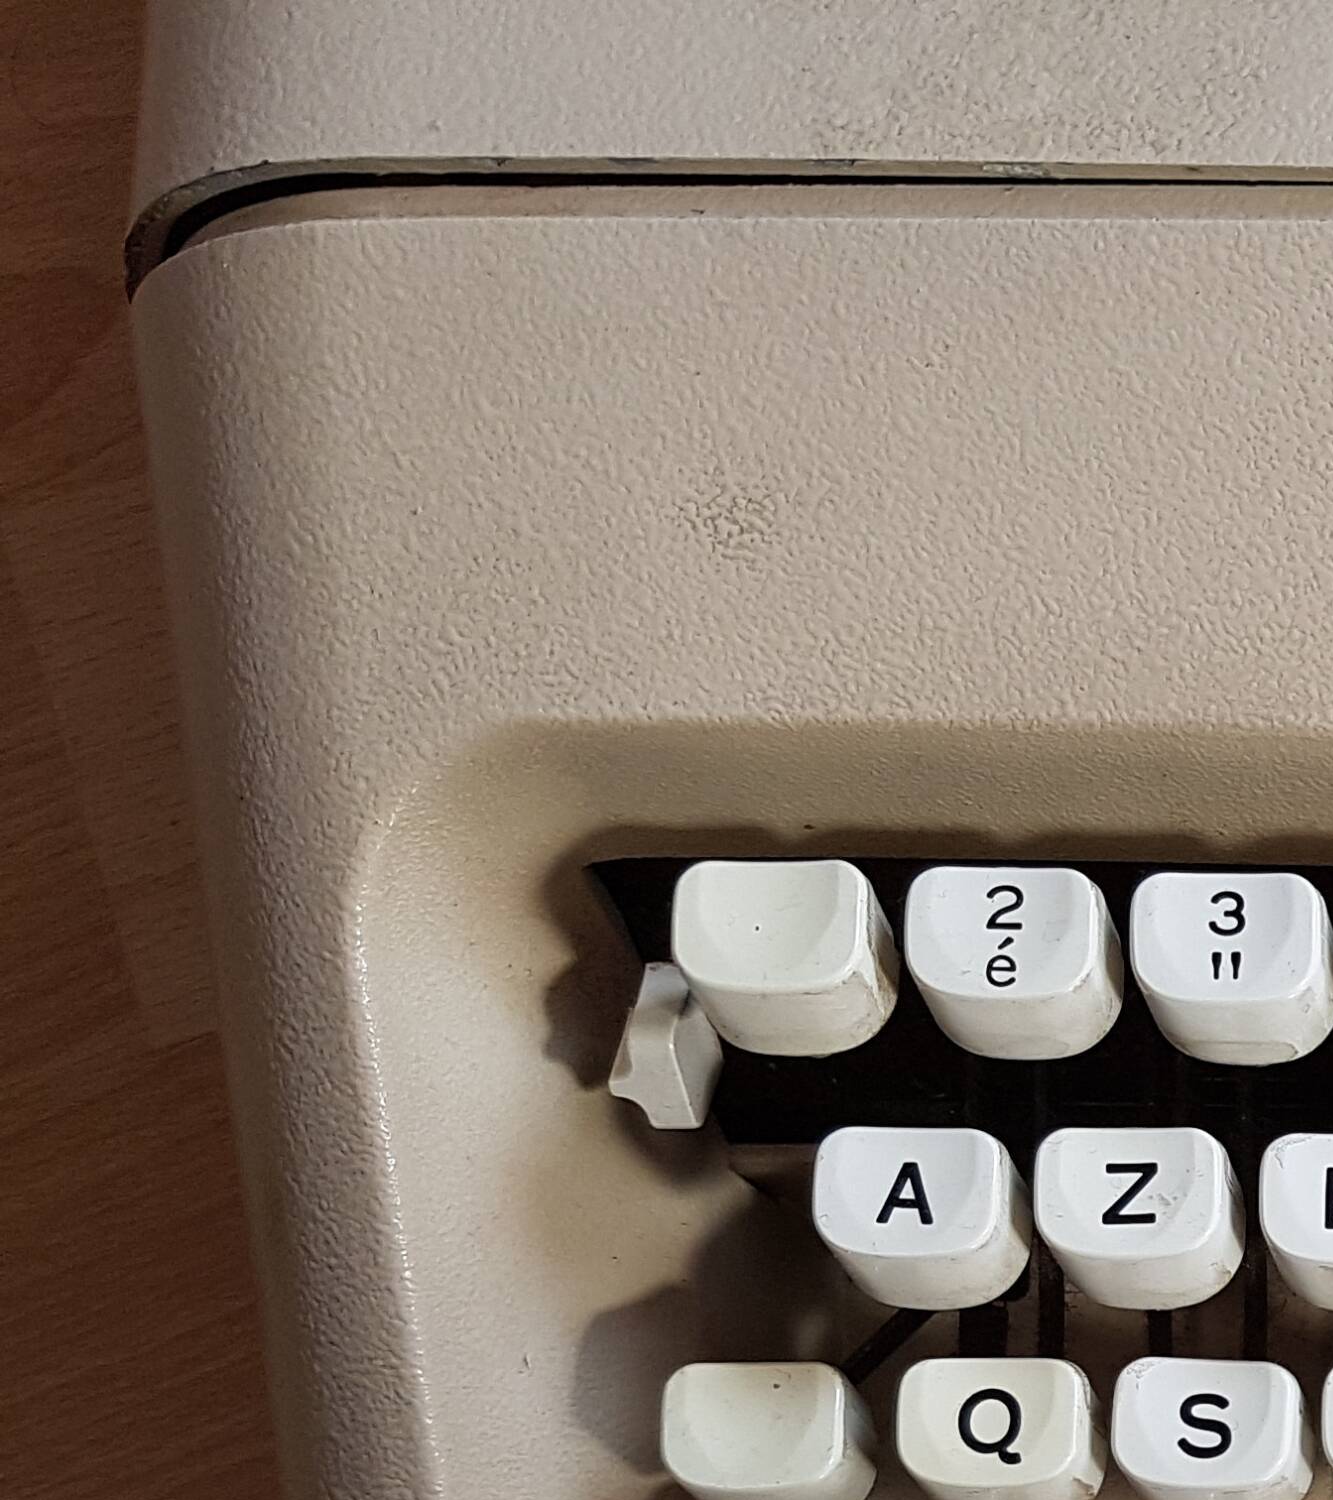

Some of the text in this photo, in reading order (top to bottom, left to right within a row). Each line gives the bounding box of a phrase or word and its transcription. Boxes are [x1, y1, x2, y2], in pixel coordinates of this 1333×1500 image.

[985, 884, 1024, 930] 2
[1208, 890, 1246, 937] 3
[985, 936, 1017, 988] é
[875, 1161, 934, 1225] A
[1101, 1162, 1158, 1225] Z
[957, 1388, 1022, 1465] Q
[1177, 1393, 1232, 1459] S
